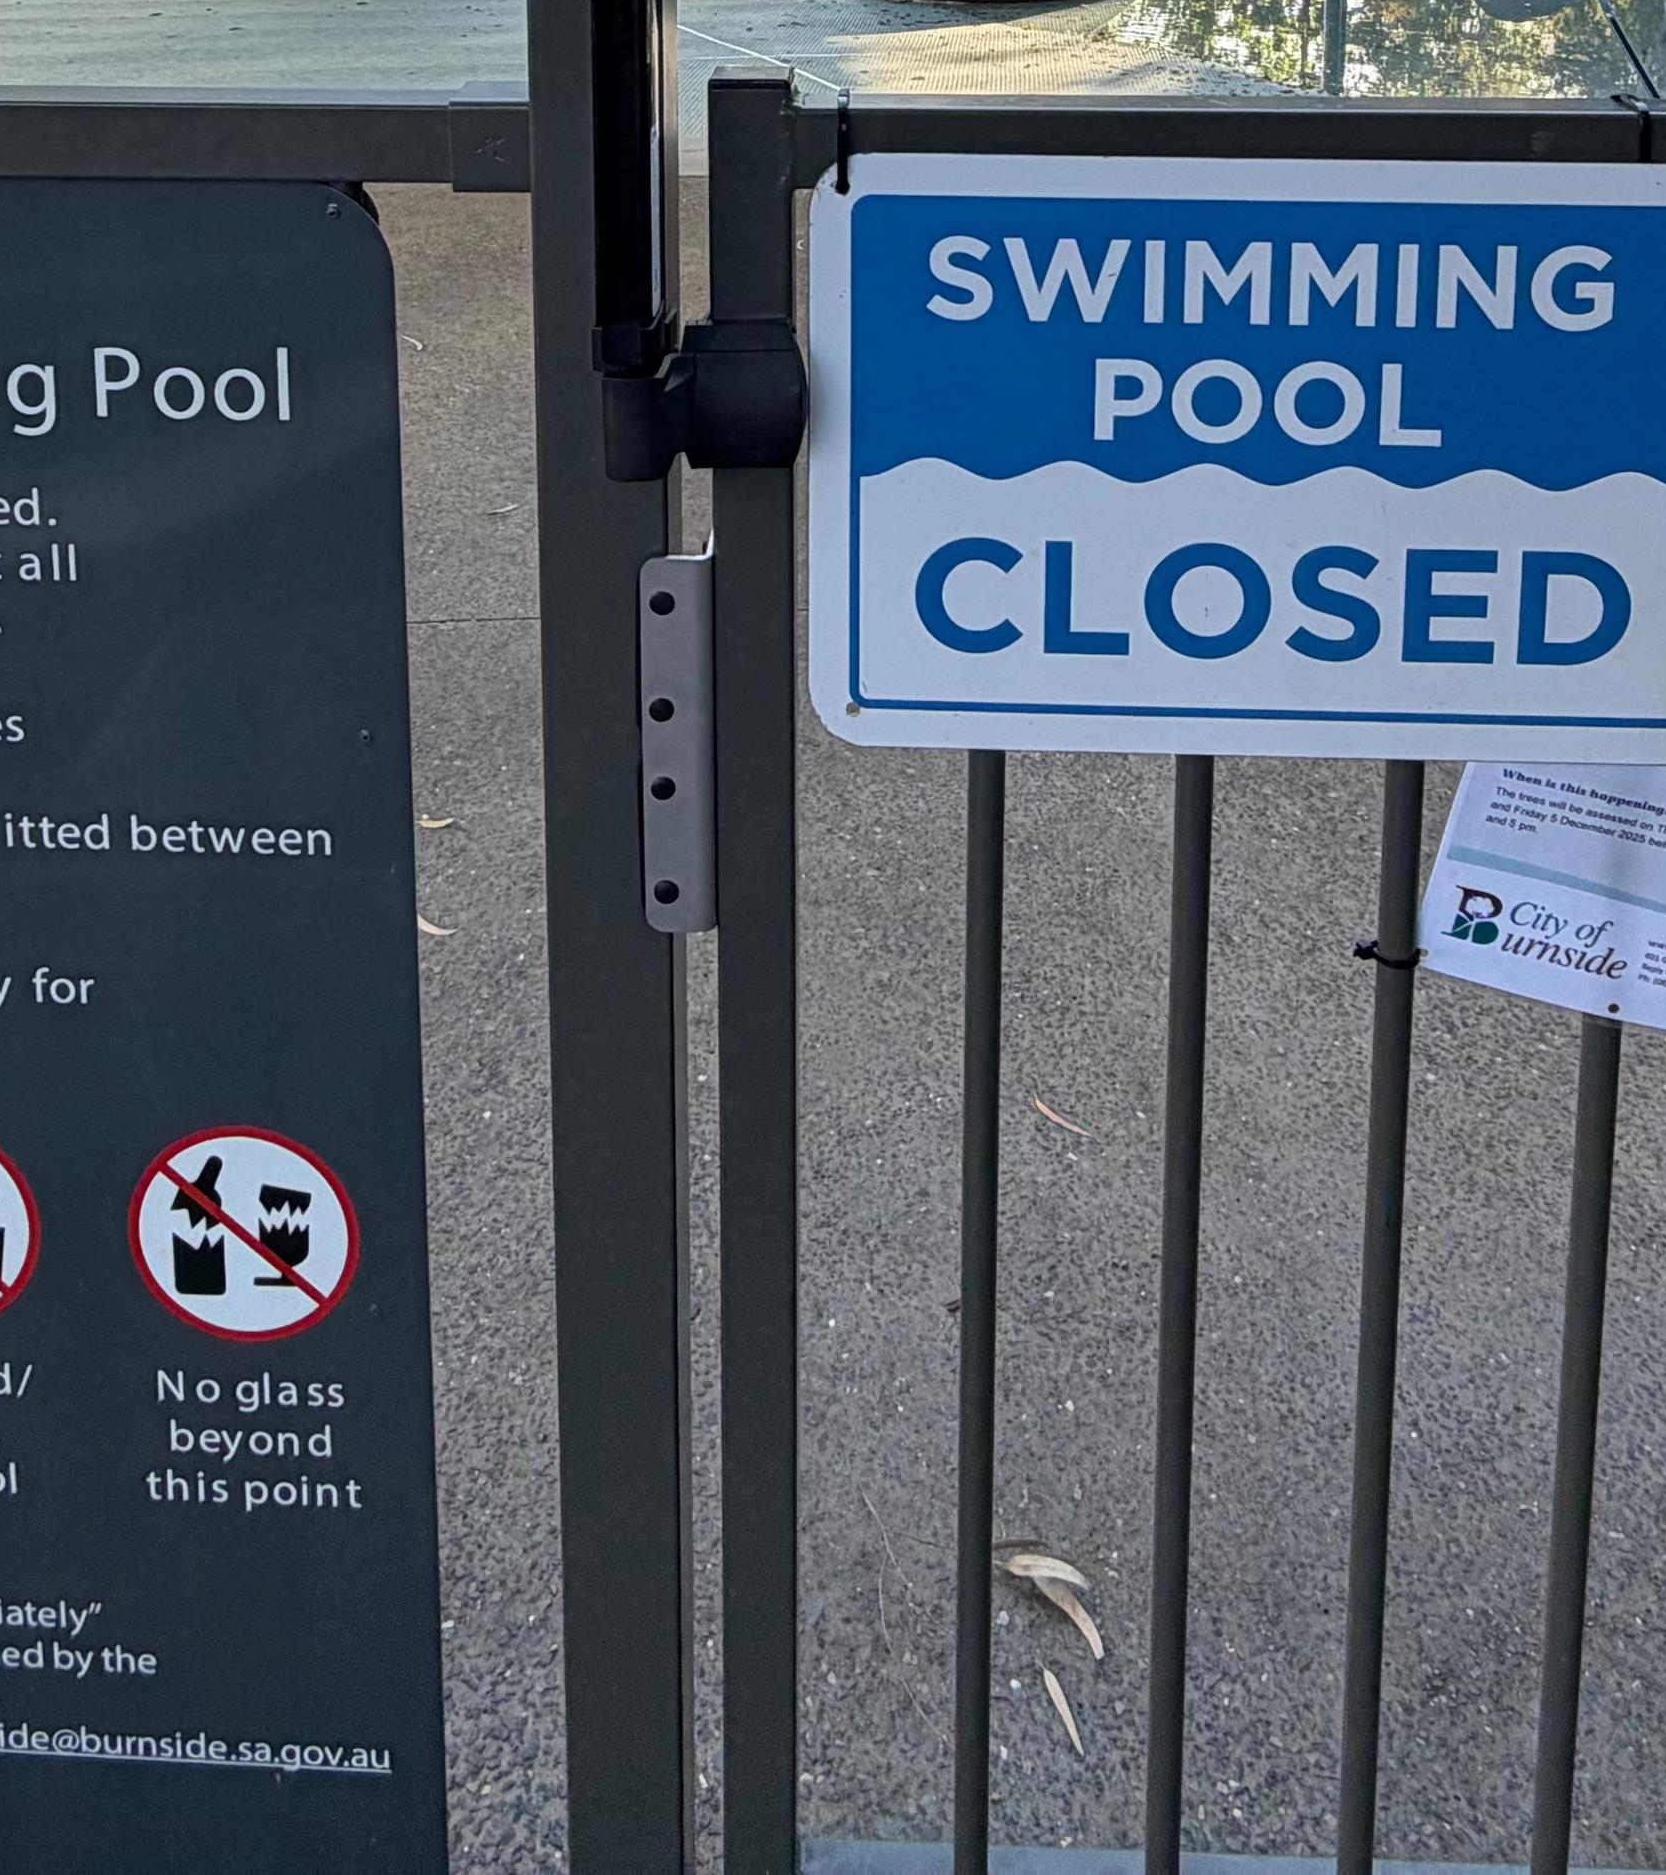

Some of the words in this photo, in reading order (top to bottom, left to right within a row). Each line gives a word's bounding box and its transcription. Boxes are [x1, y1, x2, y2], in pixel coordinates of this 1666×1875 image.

[926, 235, 1616, 333] SWIMMING
[94, 347, 290, 421] Pool
[1093, 358, 1442, 448] POOL
[19, 543, 76, 581] all
[915, 536, 1632, 666] CLOSED
[131, 815, 331, 855] between
[1509, 901, 1569, 940] City
[1574, 919, 1615, 949] of
[32, 967, 94, 1004] for
[157, 1370, 220, 1403] No
[236, 1372, 344, 1412] glass
[170, 1419, 332, 1463] beyond
[146, 1469, 228, 1503] this
[245, 1476, 362, 1512] point
[53, 1642, 94, 1678] by
[101, 1645, 157, 1674] the
